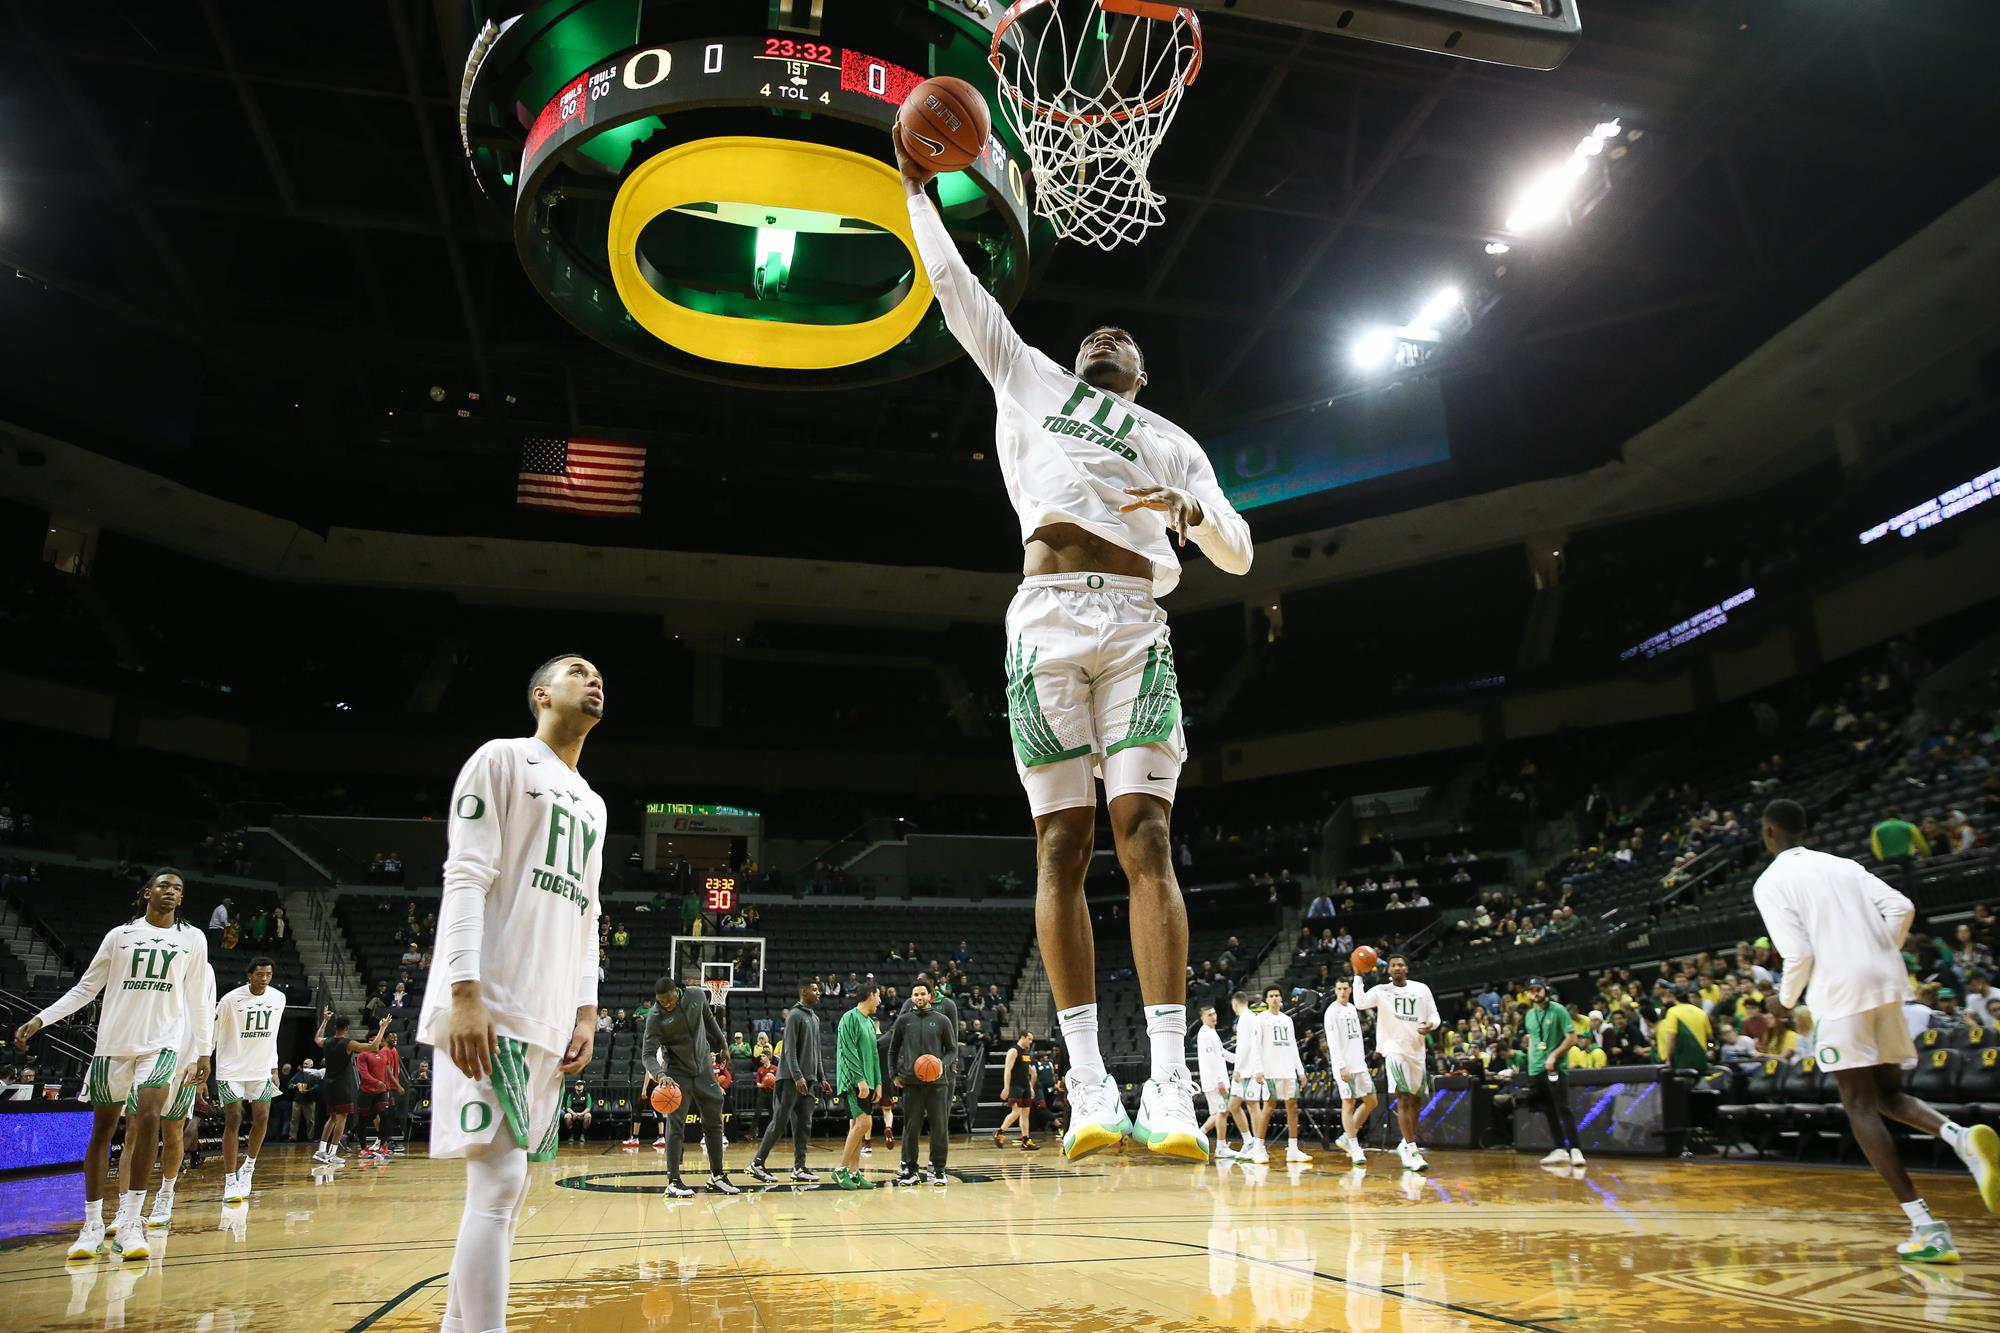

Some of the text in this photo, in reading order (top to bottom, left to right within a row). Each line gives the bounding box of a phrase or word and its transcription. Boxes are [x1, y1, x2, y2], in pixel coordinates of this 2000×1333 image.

[704, 44, 723, 74] 0
[765, 38, 832, 63] 23:32
[588, 66, 617, 88] FOULS
[623, 49, 672, 90] O
[787, 61, 810, 76] 1ST
[868, 63, 886, 95] 0
[560, 84, 582, 107] FOULS
[591, 82, 610, 101] 00
[760, 83, 831, 104] 4 TOL 4
[561, 100, 577, 120] 00
[1087, 574, 1105, 589] O
[456, 794, 485, 820] O
[545, 802, 598, 883] FLY
[531, 867, 590, 916] TOGETHR
[705, 878, 735, 890] 23:32
[708, 890, 732, 910] 30
[131, 948, 178, 980] FLY
[123, 980, 173, 992] TOGETHER
[1394, 997, 1417, 1015] FLY
[245, 1010, 272, 1031] FLY
[1273, 1025, 1288, 1041] FLY
[1819, 1046, 1840, 1065] O
[460, 1101, 492, 1133] O
